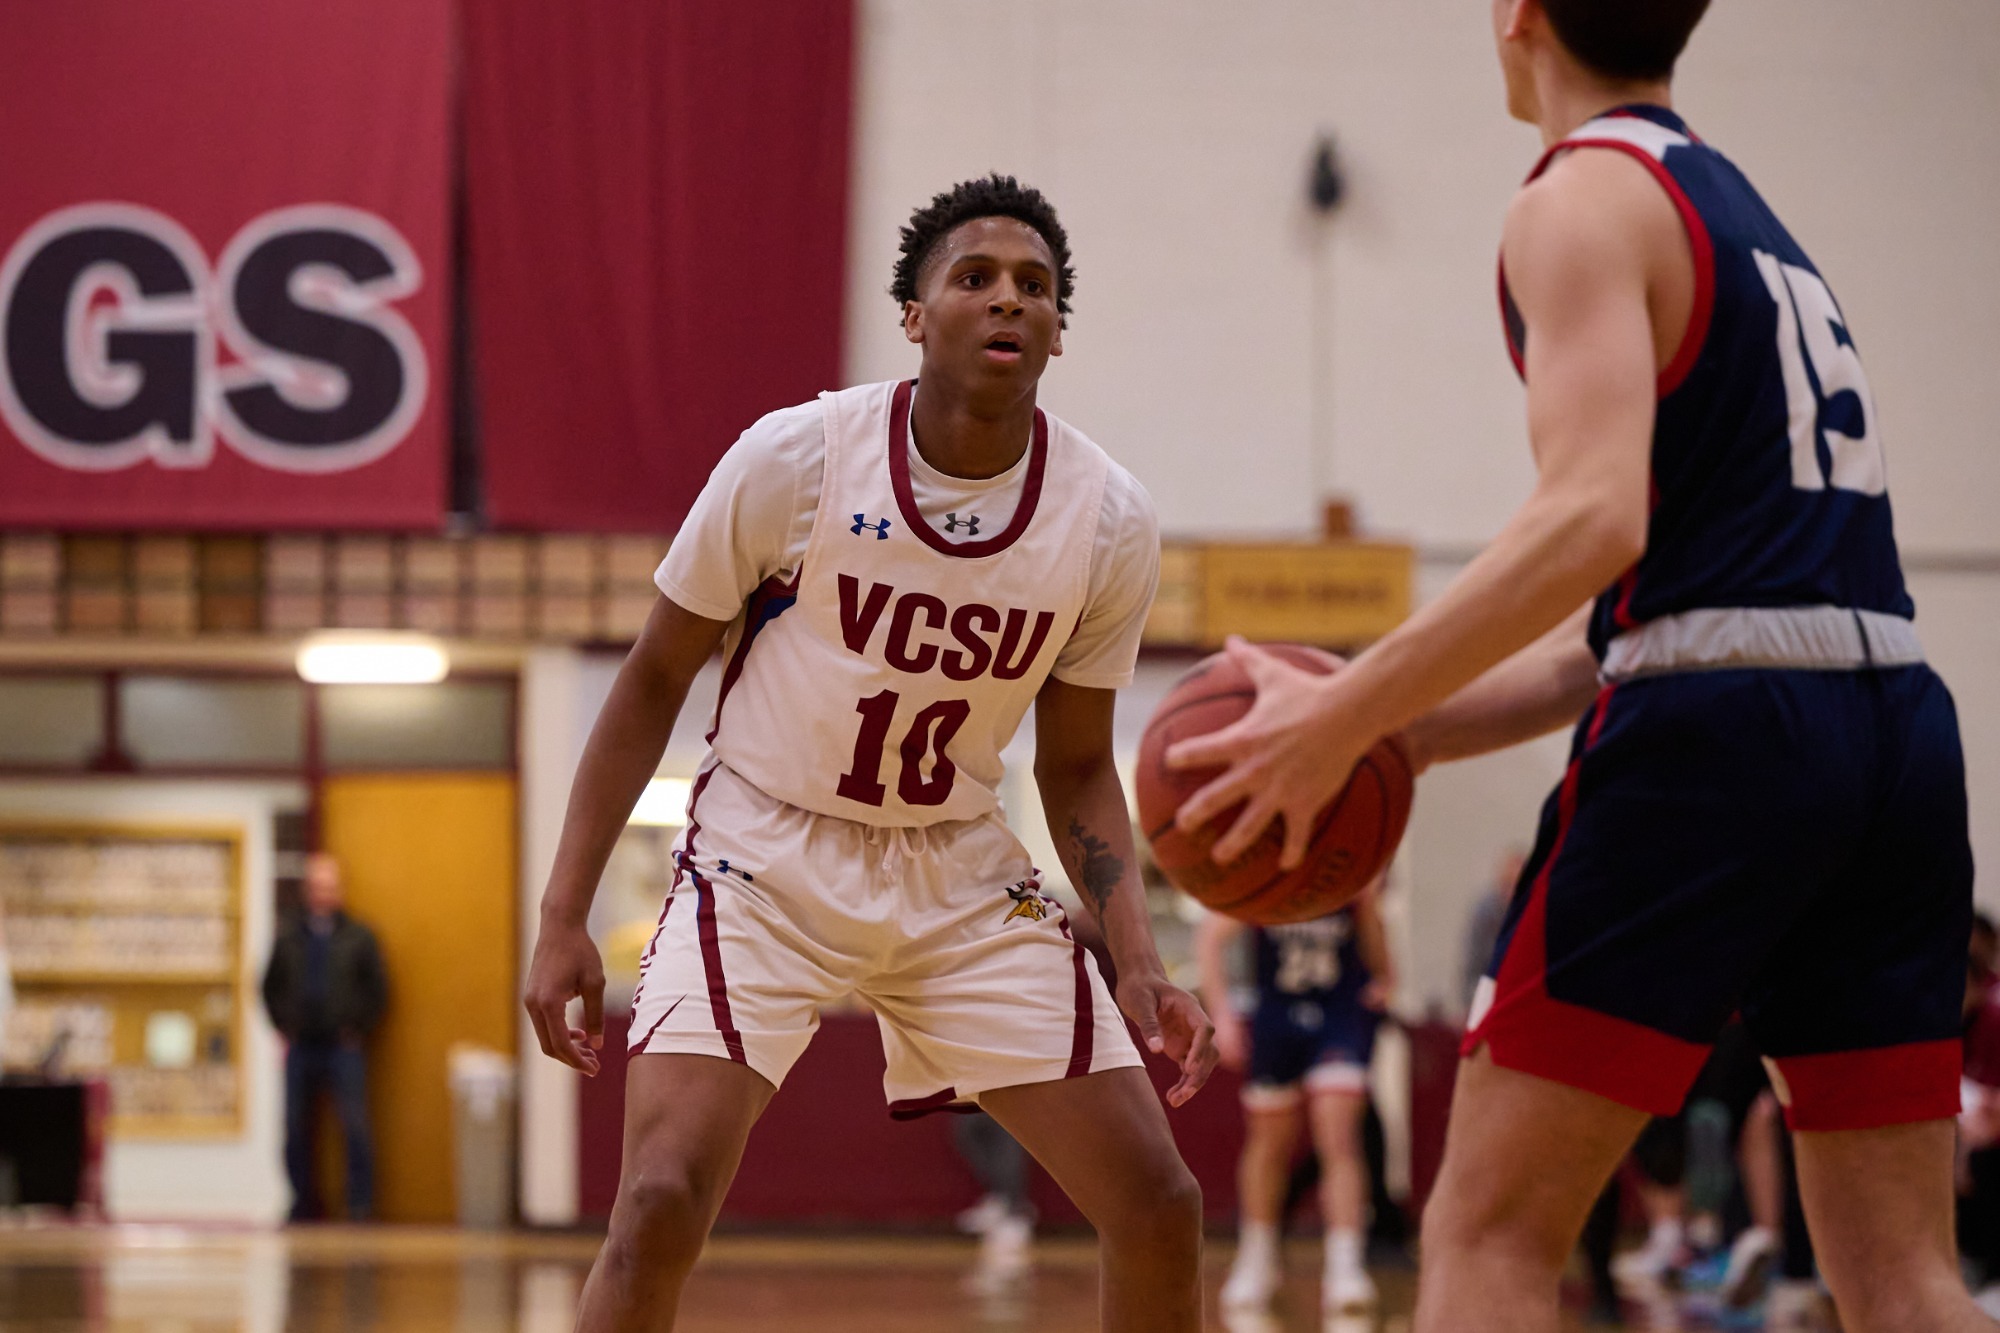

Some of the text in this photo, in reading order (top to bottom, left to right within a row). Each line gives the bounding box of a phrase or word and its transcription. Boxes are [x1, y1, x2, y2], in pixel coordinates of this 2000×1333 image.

[0, 202, 429, 474] GS
[1751, 248, 1887, 497] 15
[838, 573, 1055, 681] VCSU
[836, 689, 971, 807] 10
